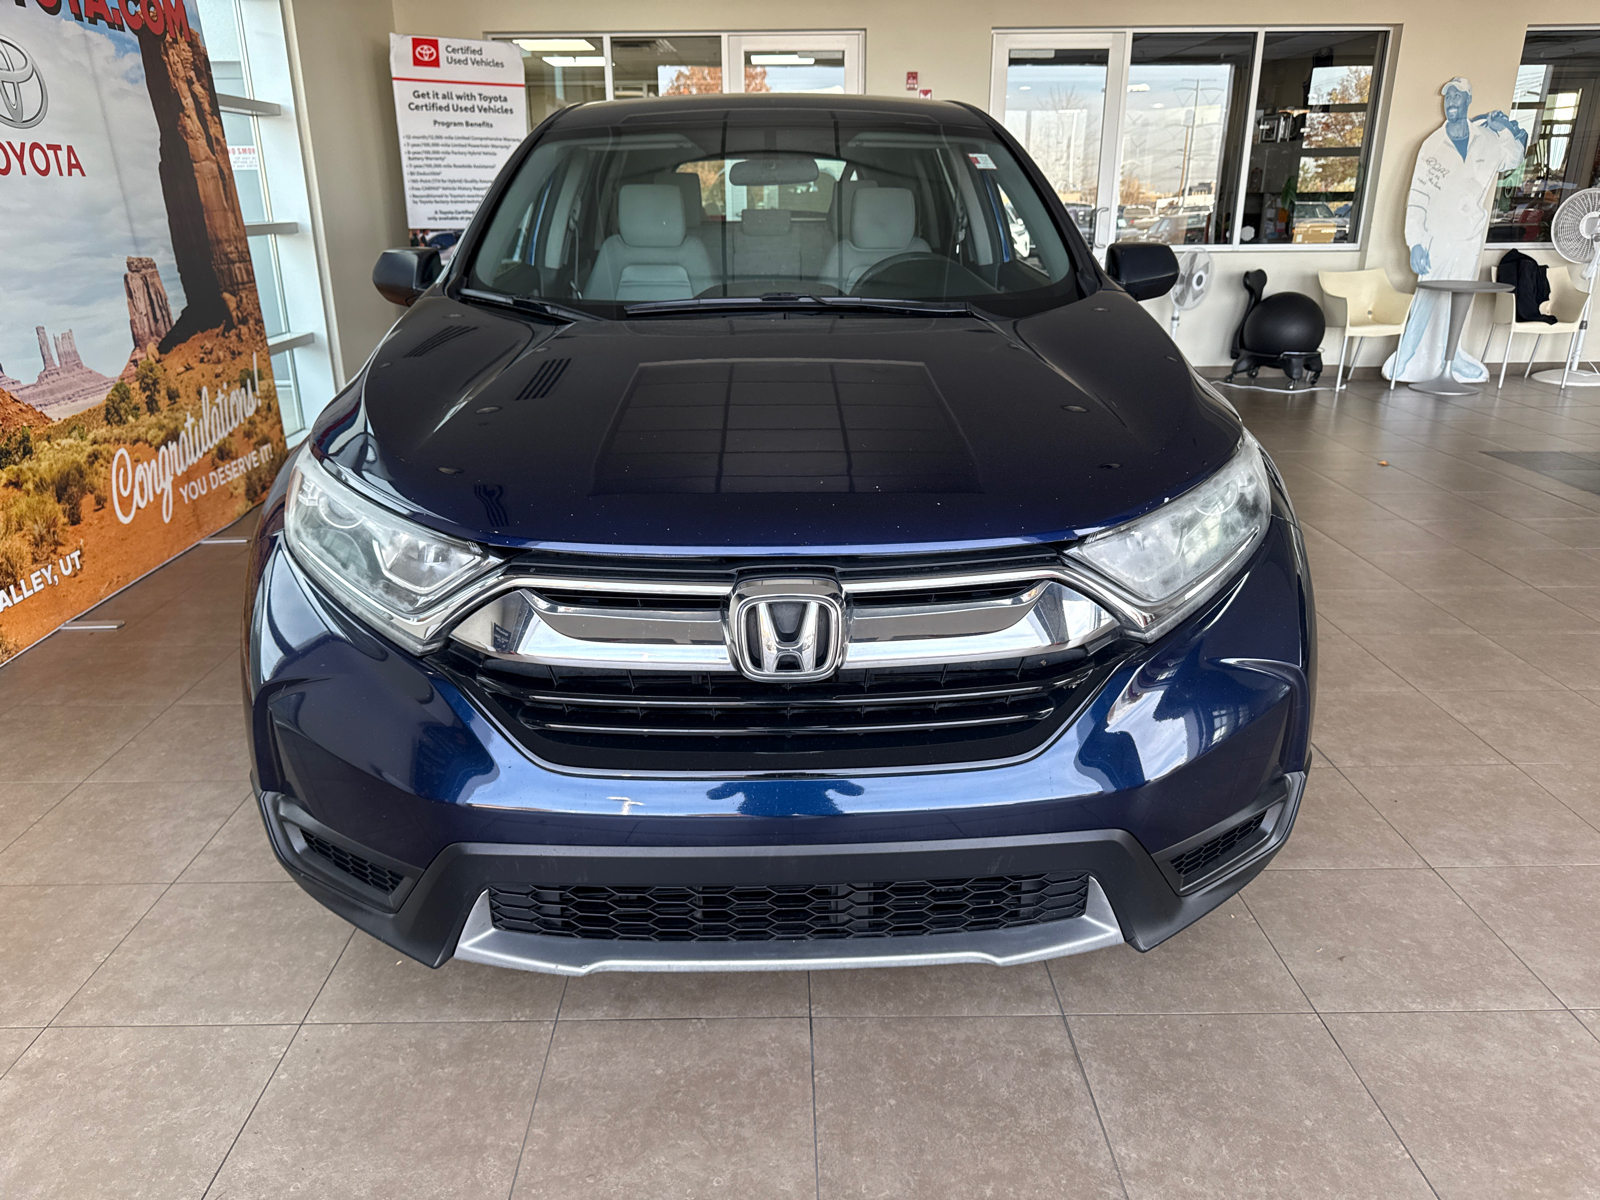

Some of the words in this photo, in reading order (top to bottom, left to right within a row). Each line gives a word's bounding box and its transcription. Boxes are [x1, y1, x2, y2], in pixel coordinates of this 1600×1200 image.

[445, 45, 483, 56] Certified
[446, 56, 469, 66] Used
[470, 57, 505, 69] Vehicles
[412, 90, 431, 100] Get
[432, 90, 440, 100] it
[441, 91, 453, 101] all
[455, 92, 476, 102] with
[477, 93, 508, 104] Toyota
[408, 102, 450, 112] Certified
[451, 104, 476, 113] Used
[477, 105, 514, 115] Vehicles
[433, 119, 464, 129] Program
[465, 120, 494, 128] Benefits
[111, 352, 262, 525] Congratulations!
[179, 480, 208, 504] YOU
[209, 456, 259, 490] DESERVE
[259, 443, 274, 468] IT!
[58, 549, 81, 576] UT
